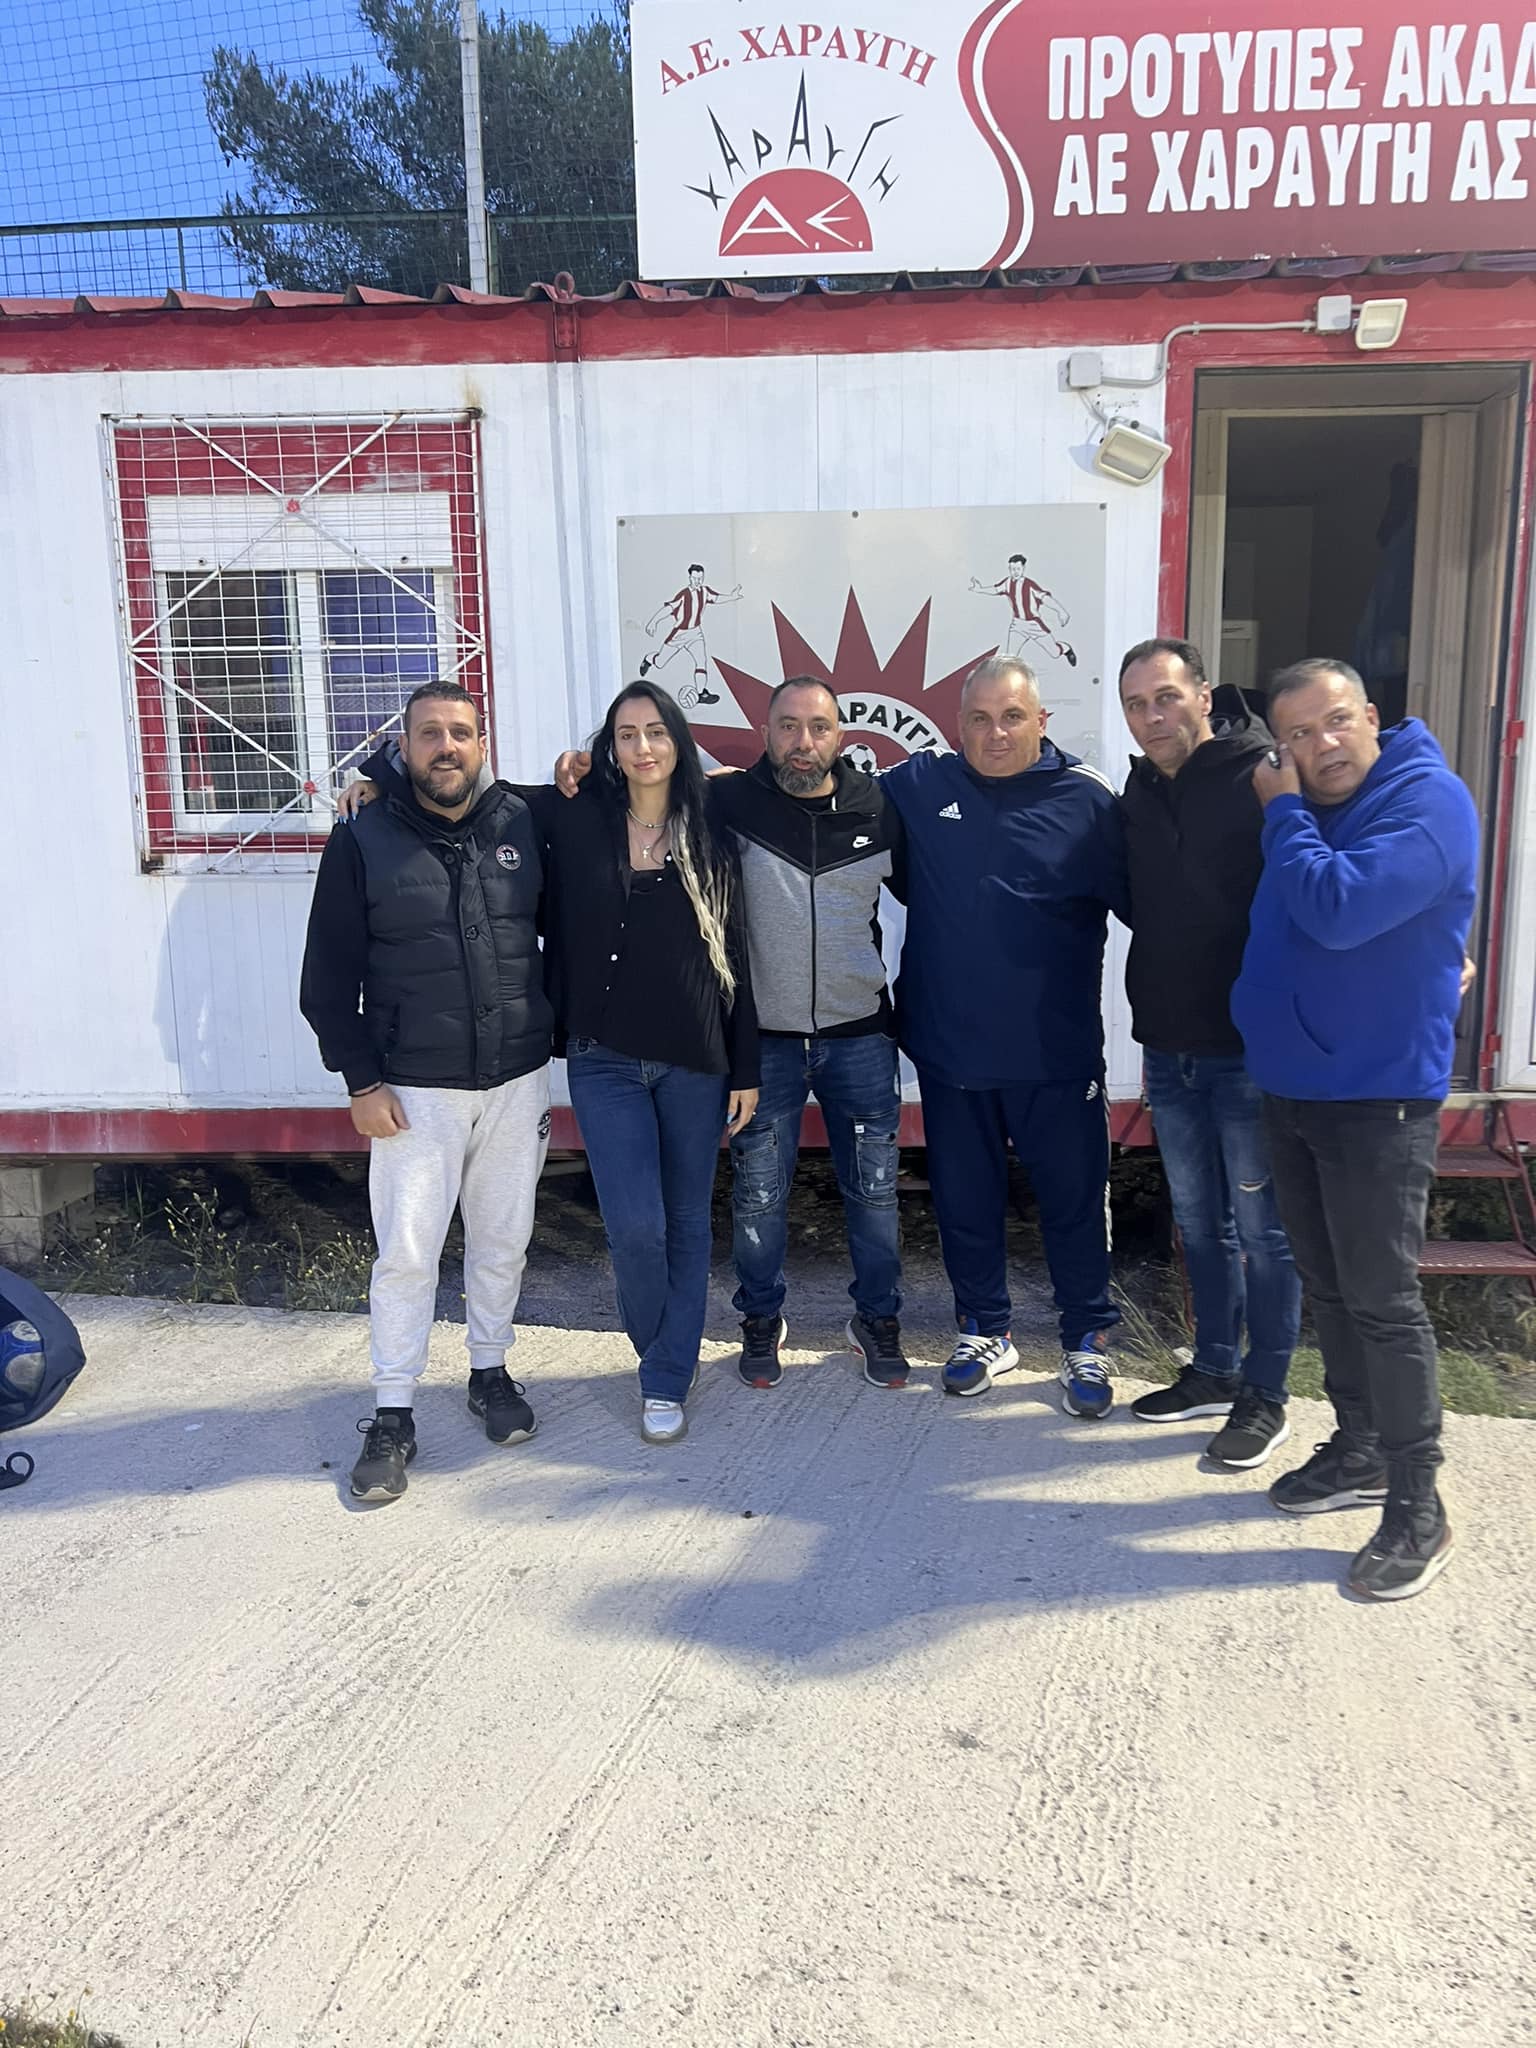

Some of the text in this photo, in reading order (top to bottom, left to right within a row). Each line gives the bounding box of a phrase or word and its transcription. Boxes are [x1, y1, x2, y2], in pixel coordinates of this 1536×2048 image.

[661, 23, 937, 95] Α.Ε. ΧΑΡΑΥΓΗ
[1048, 22, 1536, 120] ΠΡΟΤΥΠΕΣ ΑΚΑΔ
[682, 68, 904, 211] ΧΑΡΑΥΓΗ
[1053, 118, 1536, 217] ΑΕ ΧΑΡΑΥΓΗ ΑΣ
